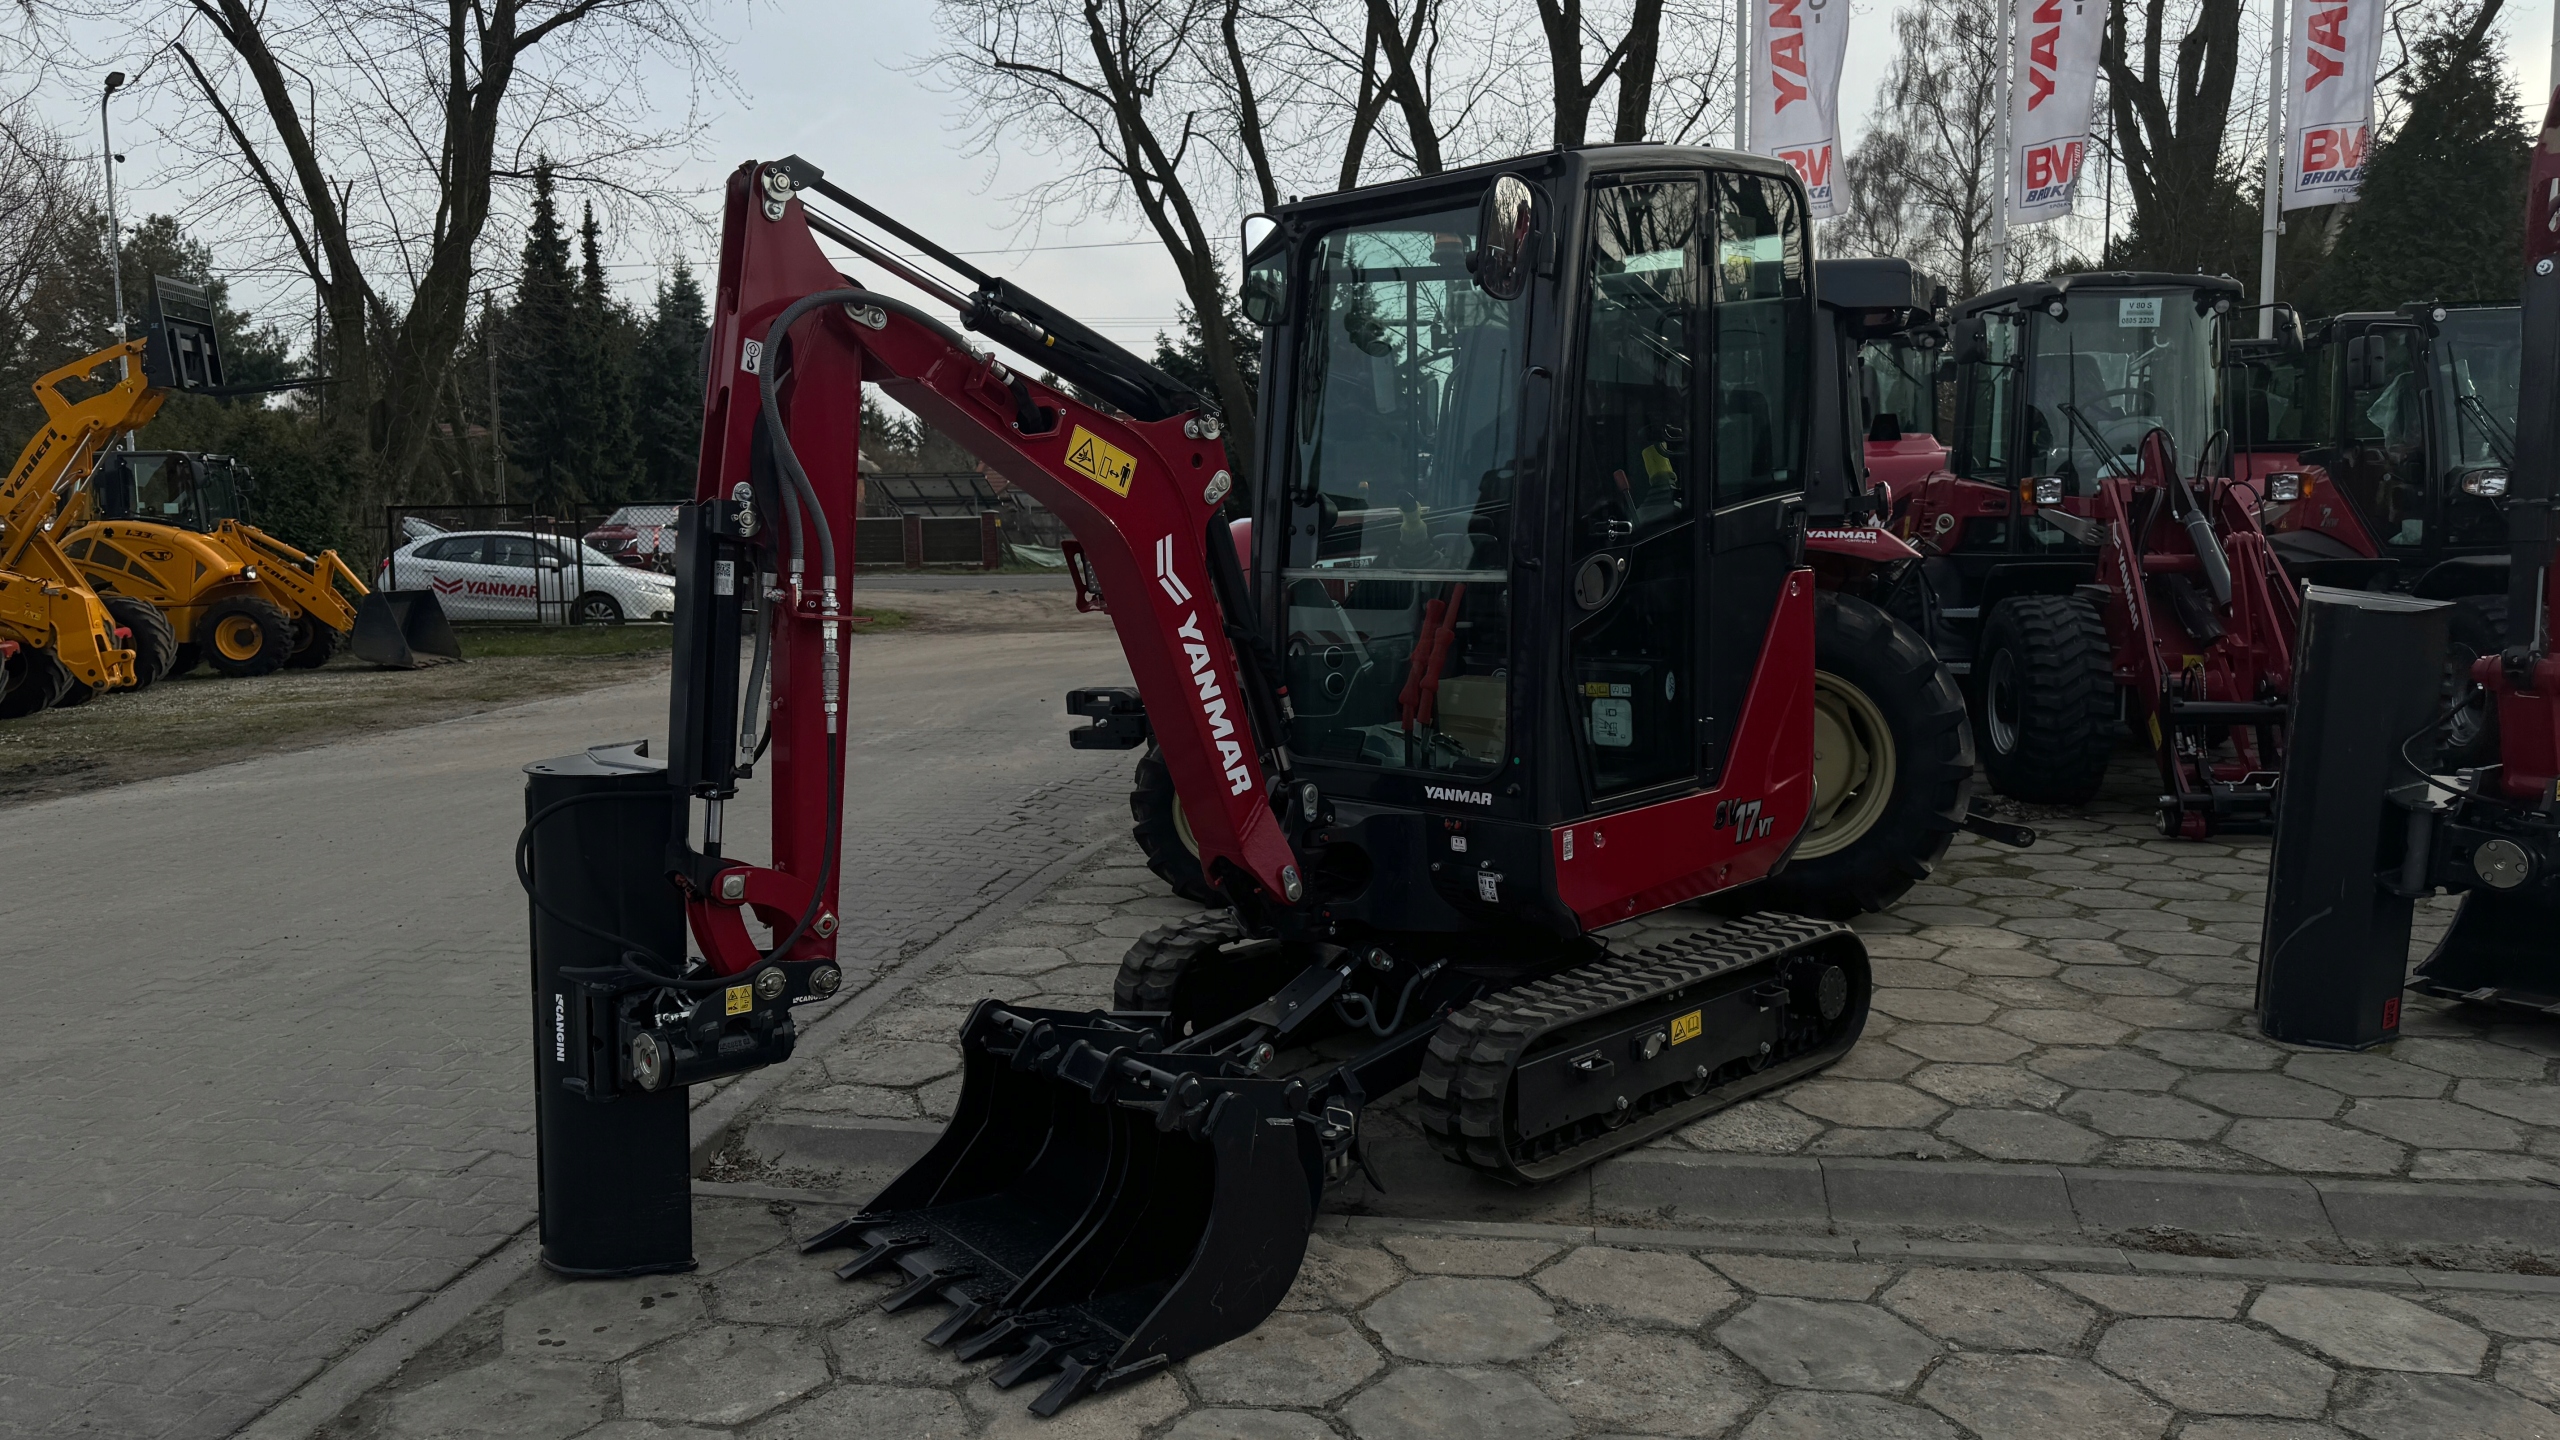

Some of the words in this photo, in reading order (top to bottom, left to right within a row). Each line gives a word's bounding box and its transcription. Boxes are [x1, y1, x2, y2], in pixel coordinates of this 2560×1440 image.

[1807, 530, 1877, 540] YANMAR
[2118, 548, 2139, 631] YANMAR
[1177, 610, 1253, 796] YANMAR
[1424, 785, 1493, 806] YANMAR
[555, 1005, 566, 1062] CANGINI
